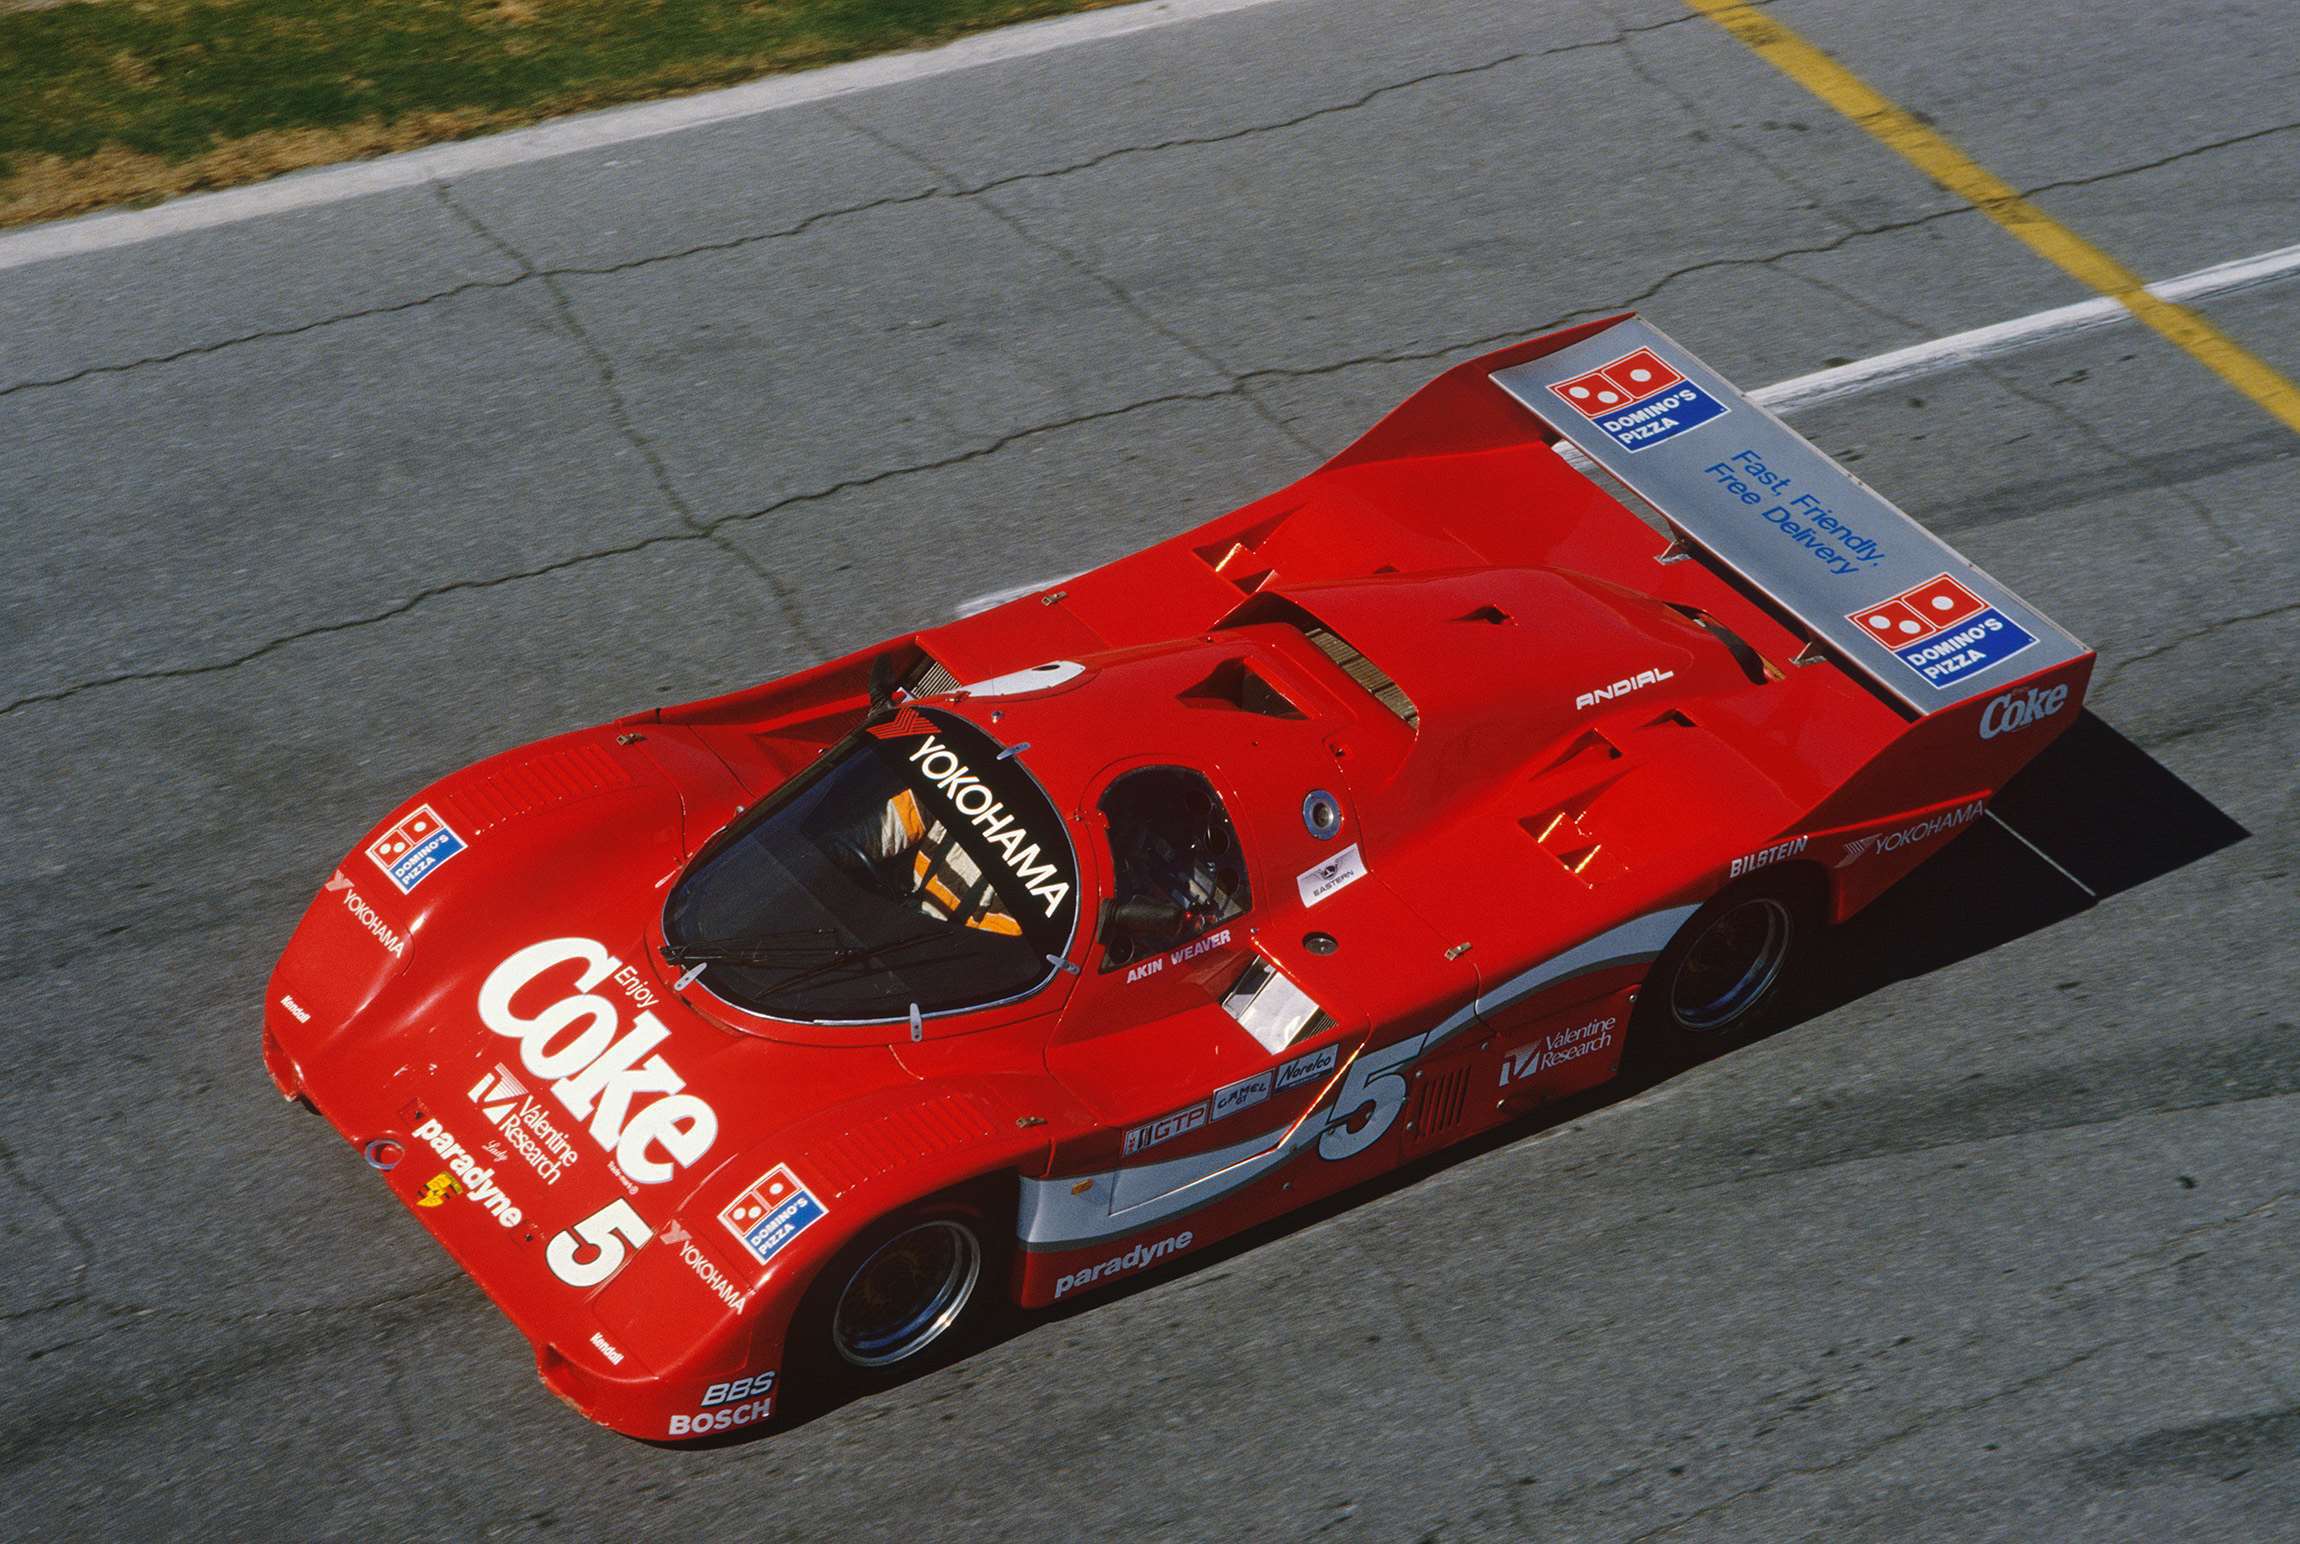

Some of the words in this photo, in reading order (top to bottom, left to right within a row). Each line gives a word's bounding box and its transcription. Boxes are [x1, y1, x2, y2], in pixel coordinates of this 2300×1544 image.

[1603, 389, 1697, 433] DOMINO'S
[1618, 417, 1680, 444] PIZZA
[1731, 450, 1791, 497] Fast,
[1704, 462, 1761, 505] Free
[1761, 506, 1859, 576] Delivery
[1906, 617, 2004, 667] DOMINO'S
[1922, 649, 1986, 680] PIZZA
[1575, 667, 1675, 710] ANDIAL
[1979, 683, 2069, 740] Coke
[908, 735, 1071, 919] YOKOHAMA
[1873, 799, 1985, 855] YOKOHAMA
[394, 833, 450, 878] DOMINO'S
[402, 856, 437, 886] PIZZA
[1729, 837, 1809, 880] BILSTEIN
[1313, 869, 1354, 897] EASTERN
[342, 888, 406, 959] YOKOHAMA
[1126, 957, 1163, 984] AKIN
[1170, 929, 1232, 965] WEAVER
[280, 995, 312, 1024] Kendall
[613, 965, 660, 1009] Enjoy
[1540, 1031, 1612, 1071] Research
[1545, 1017, 1616, 1051] Valentine
[478, 937, 719, 1184] Coke
[1277, 1053, 1331, 1087] Norelco
[1217, 1082, 1267, 1110] CAMEL
[1317, 1030, 1430, 1161] 5
[499, 1114, 562, 1186] Research
[519, 1094, 579, 1168] Valentine
[411, 1118, 523, 1228] paradyne
[545, 1196, 655, 1288] 5
[750, 1197, 809, 1248] DOMINO'S
[757, 1223, 796, 1256] PIZZA
[679, 1240, 747, 1316] YOKOHAMA
[1054, 1231, 1195, 1300] paradyne
[589, 1331, 625, 1367] Kendall
[701, 1370, 777, 1407] BBS
[668, 1397, 772, 1436] BOSCH
